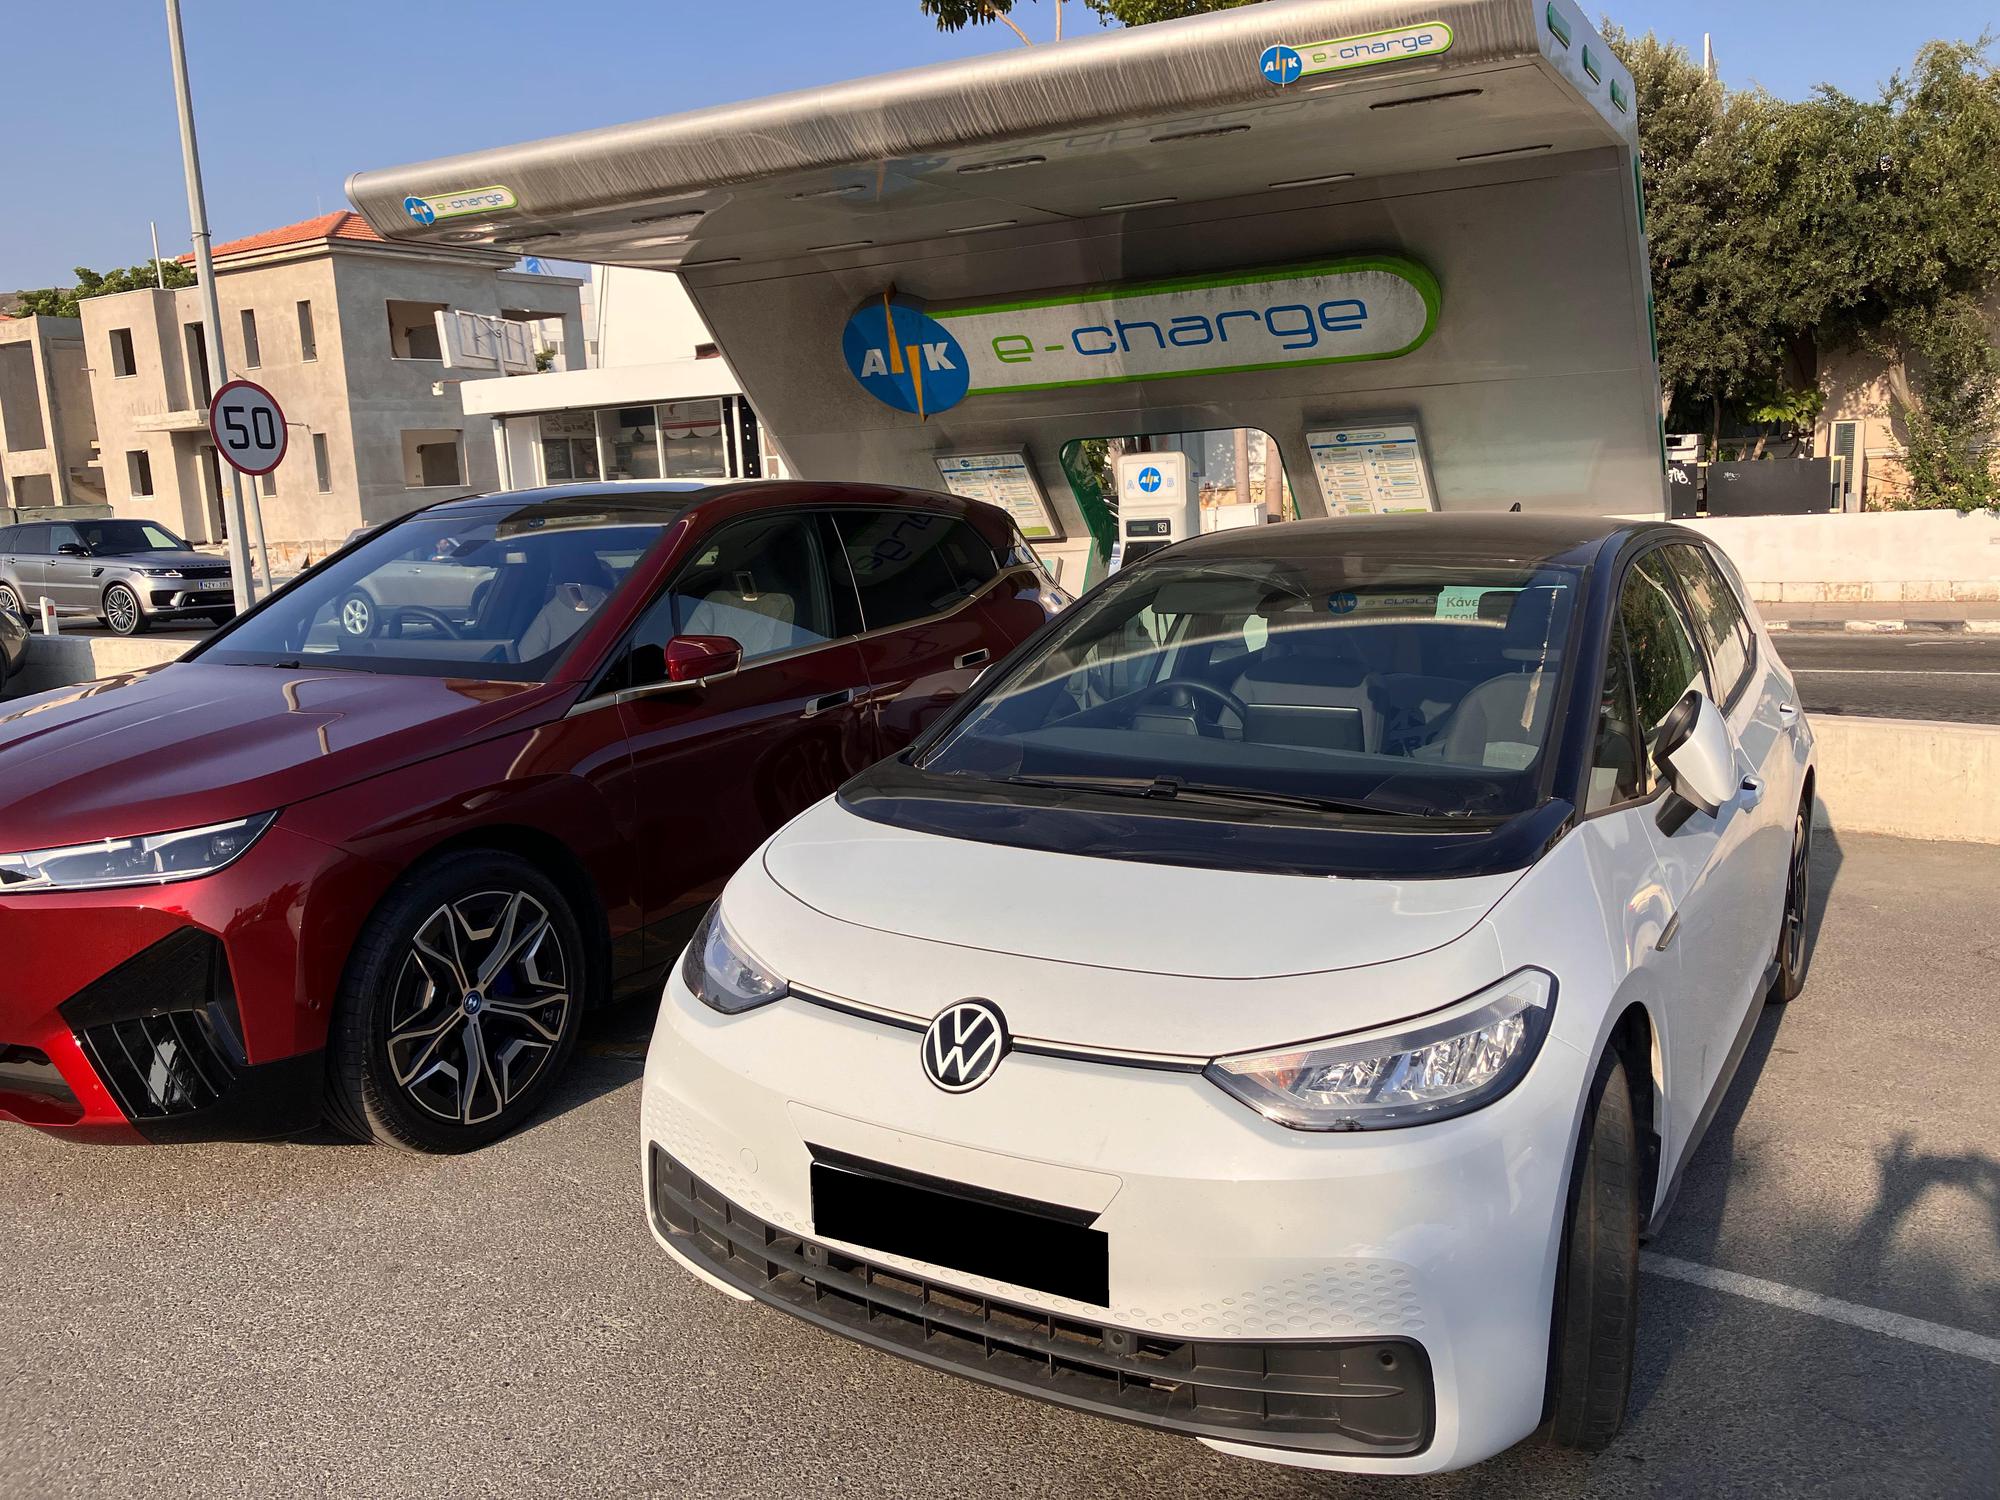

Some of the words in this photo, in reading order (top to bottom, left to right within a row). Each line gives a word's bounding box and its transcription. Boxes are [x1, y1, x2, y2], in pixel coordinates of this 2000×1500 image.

[1312, 32, 1433, 64] e-charge
[436, 193, 504, 210] e-charge
[991, 299, 1368, 363] e-charge
[223, 406, 276, 449] 50
[1446, 597, 1479, 607] Κάνε
[923, 1003, 1003, 1091] VW
